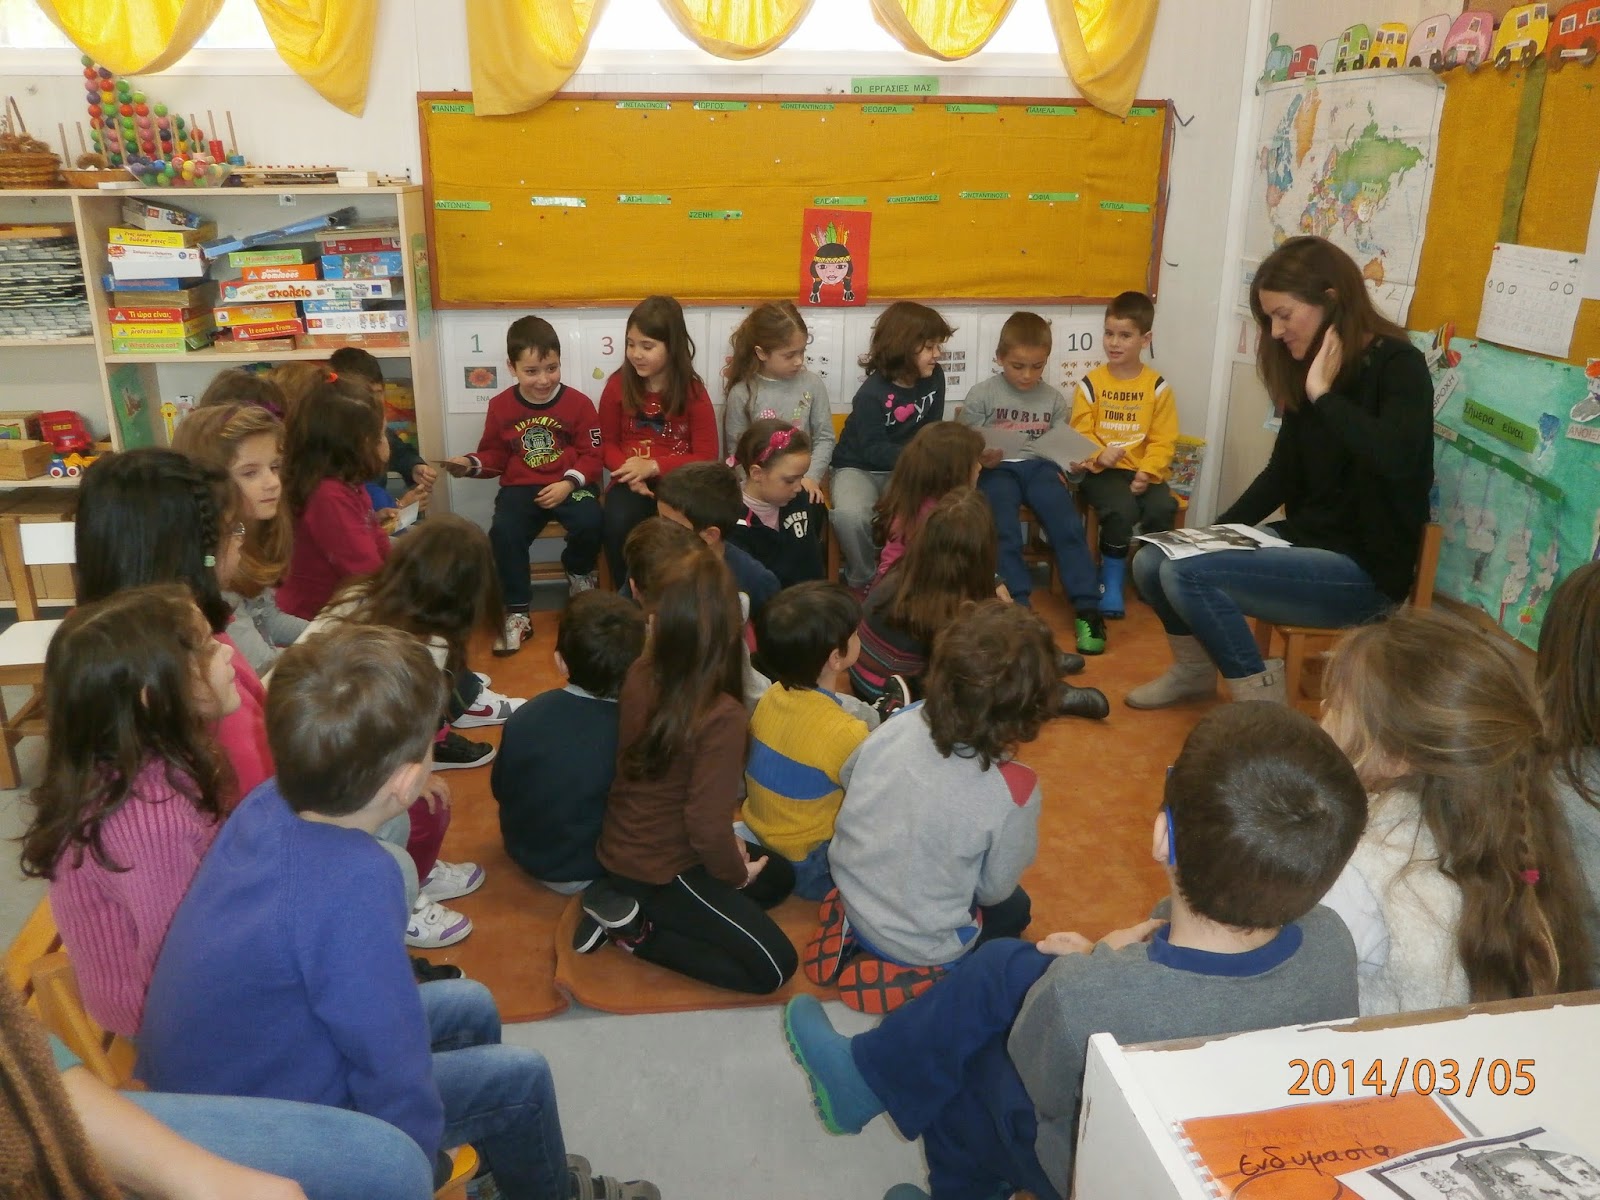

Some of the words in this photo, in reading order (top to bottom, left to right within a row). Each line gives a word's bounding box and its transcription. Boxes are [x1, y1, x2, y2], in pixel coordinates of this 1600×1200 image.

[853, 86, 862, 94] ΟΙ
[869, 84, 910, 93] ΕΡΓΑΣΙΕΣ
[913, 84, 932, 92] ΜΑΣ
[436, 201, 472, 209] ΑΝΤΩΝΗΣ
[267, 284, 312, 298] σχολείο
[470, 333, 484, 353] 1
[602, 336, 614, 356] 3
[1068, 332, 1093, 352] 10
[1101, 389, 1145, 401] ACADEMY
[996, 408, 1052, 423] WORLD
[1104, 410, 1124, 421] TOUR
[1126, 413, 1137, 421] 81
[1463, 402, 1495, 426] Σήμερα
[1502, 422, 1524, 440] είναι
[589, 428, 602, 448] 5
